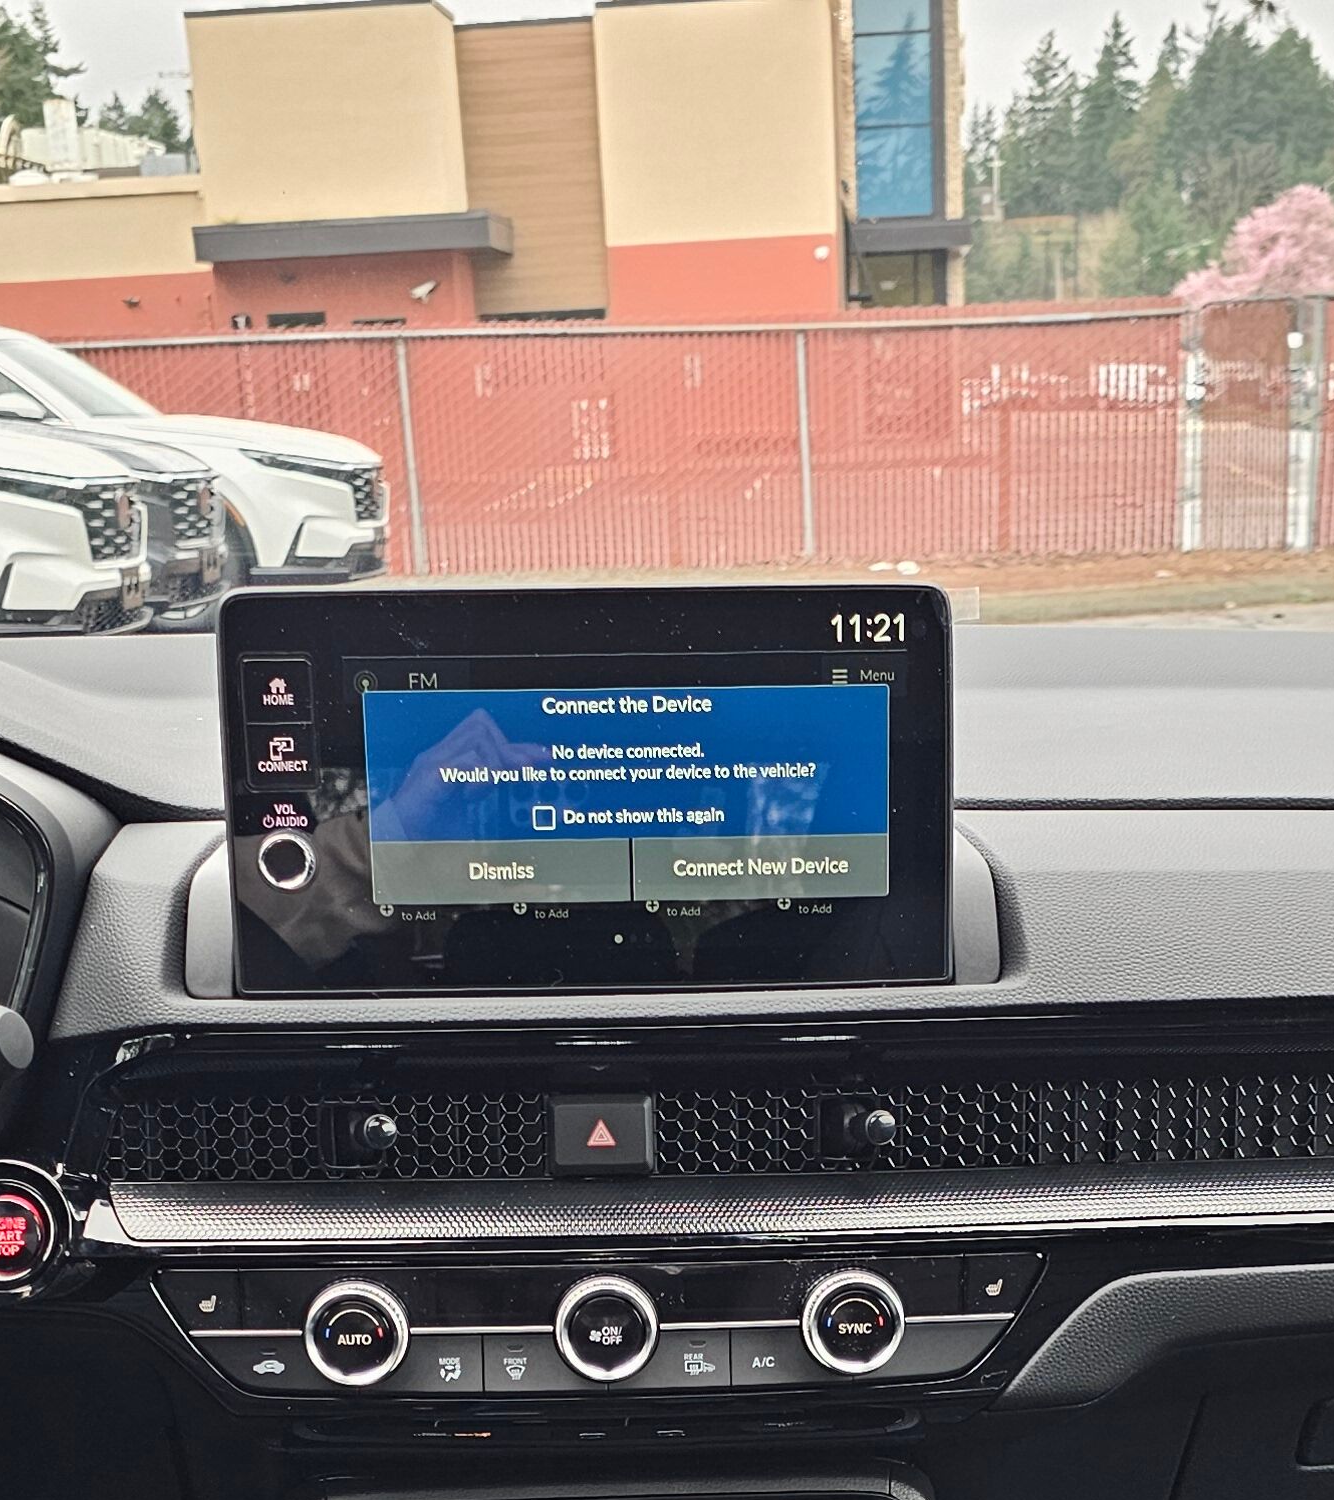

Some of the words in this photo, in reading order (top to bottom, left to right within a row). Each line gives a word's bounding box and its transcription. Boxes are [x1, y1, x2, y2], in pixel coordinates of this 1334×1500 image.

[831, 613, 905, 643] 11:21
[408, 672, 438, 689] FM
[860, 670, 895, 682] Menu
[263, 694, 294, 706] HOME
[542, 697, 615, 715] Connect
[619, 696, 648, 713] the
[652, 695, 712, 713] Device
[552, 745, 574, 760] No
[577, 744, 623, 759] device
[626, 743, 705, 758] connected.
[258, 760, 308, 772] CONNECT
[439, 767, 489, 783] Would
[491, 769, 518, 785] you
[522, 767, 547, 781] like
[550, 768, 566, 781] to
[569, 766, 627, 781] connect
[631, 766, 662, 782] your
[666, 764, 711, 779] device
[714, 764, 730, 779] to
[733, 763, 757, 778] the
[760, 763, 816, 779] vehicle?
[274, 804, 296, 815] VOL
[275, 816, 308, 827] AUDIO
[563, 809, 585, 824] Do
[588, 810, 613, 824] not
[616, 809, 654, 824] show
[657, 808, 683, 823] this
[686, 807, 724, 825] again
[468, 862, 534, 880] Dismiss
[673, 859, 743, 877] Connect
[748, 859, 786, 876] New
[791, 856, 849, 874] Device
[535, 909, 545, 919] to
[548, 909, 569, 919] Add
[667, 907, 678, 917] to
[680, 906, 701, 917] Add
[799, 904, 809, 914] to
[812, 903, 832, 914] Add
[402, 911, 412, 920] to
[415, 911, 436, 921] Add
[602, 1326, 622, 1336] ON/
[839, 1322, 872, 1336] SYNC
[337, 1333, 372, 1346] AUTO
[602, 1336, 623, 1345] OFF
[503, 1357, 527, 1365] FRONT
[684, 1353, 704, 1361] REAR
[752, 1356, 775, 1369] A/C
